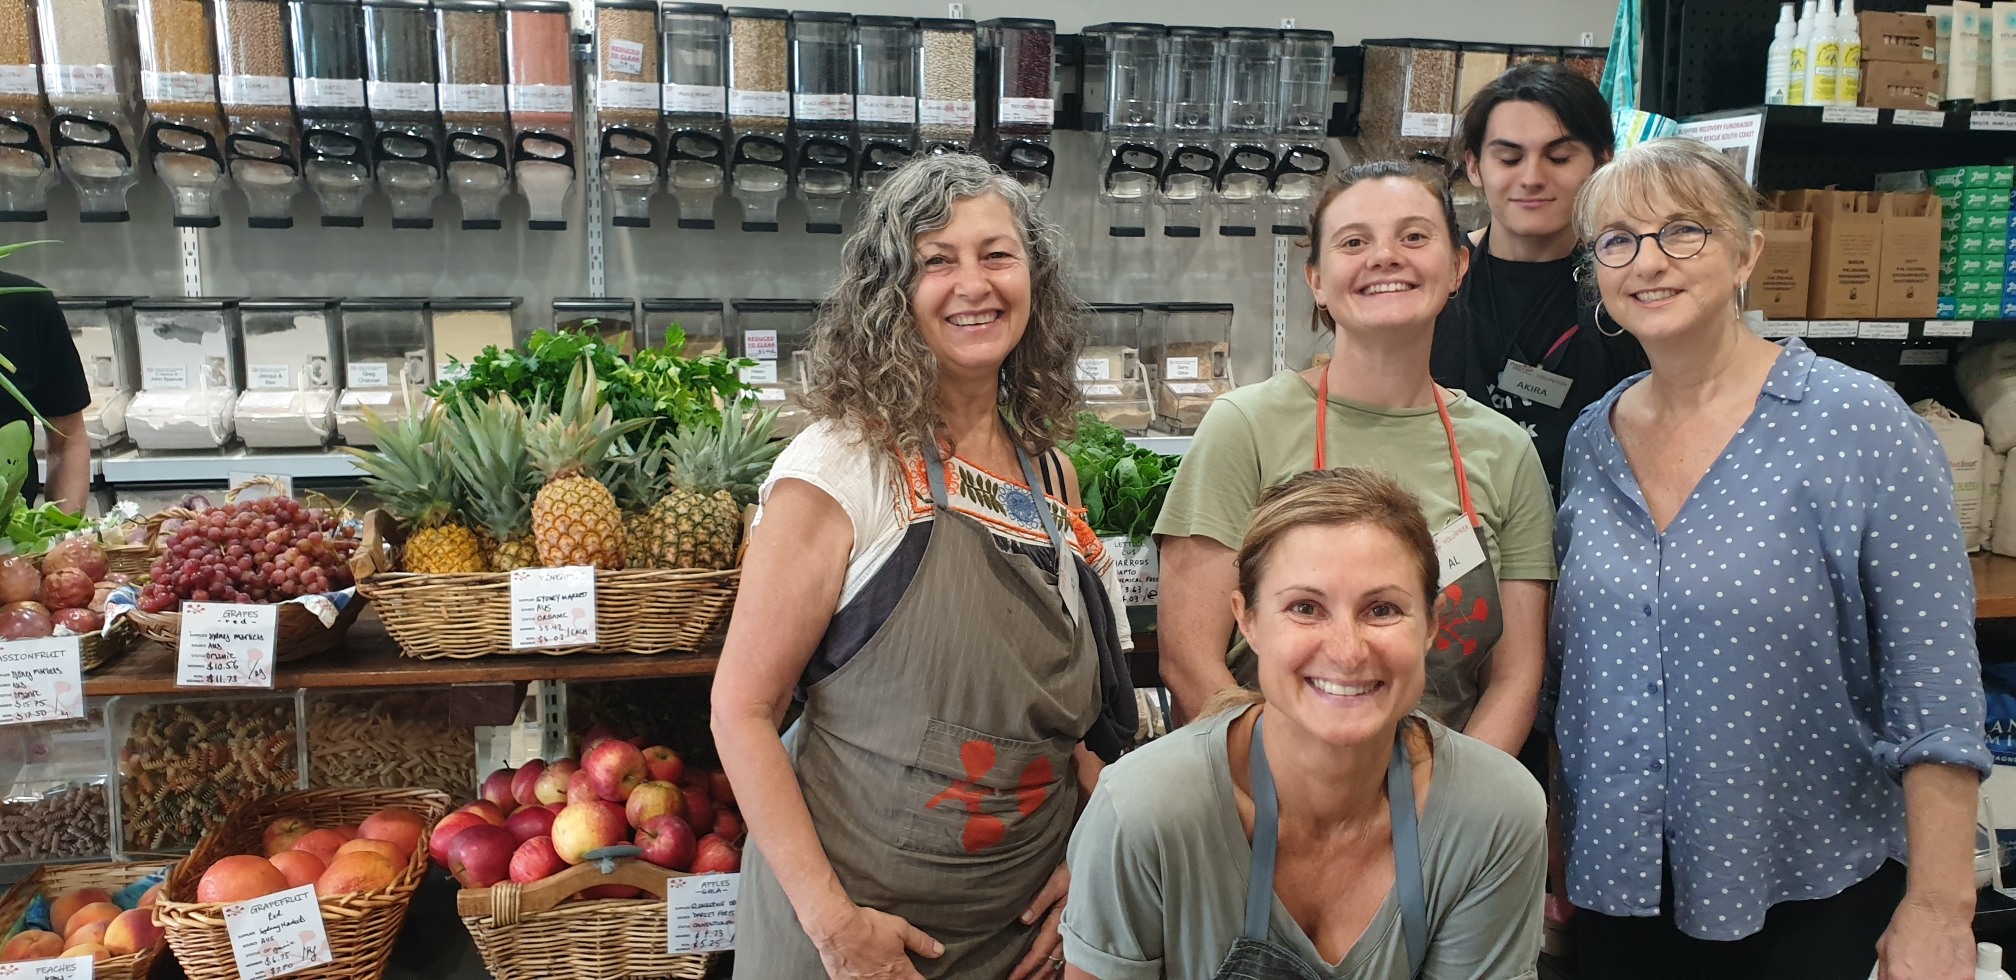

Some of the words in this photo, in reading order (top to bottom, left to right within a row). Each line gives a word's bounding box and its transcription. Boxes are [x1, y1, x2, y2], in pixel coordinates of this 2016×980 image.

[1738, 130, 1755, 139] COAST
[1516, 381, 1548, 397] AKIRA
[1443, 525, 1469, 545] VOLUNTEER
[1448, 556, 1461, 570] AL
[536, 594, 560, 603] SYDNEY
[536, 604, 552, 612] AUS
[222, 609, 259, 619] GRAPES
[537, 613, 569, 621] ORGANIC
[206, 660, 239, 671] $10.56
[206, 674, 238, 684] $11.73
[701, 879, 731, 889] APPLES
[250, 891, 309, 914] GRAPEFRUIT
[268, 909, 283, 921] Red
[36, 963, 77, 975] PEACHES
